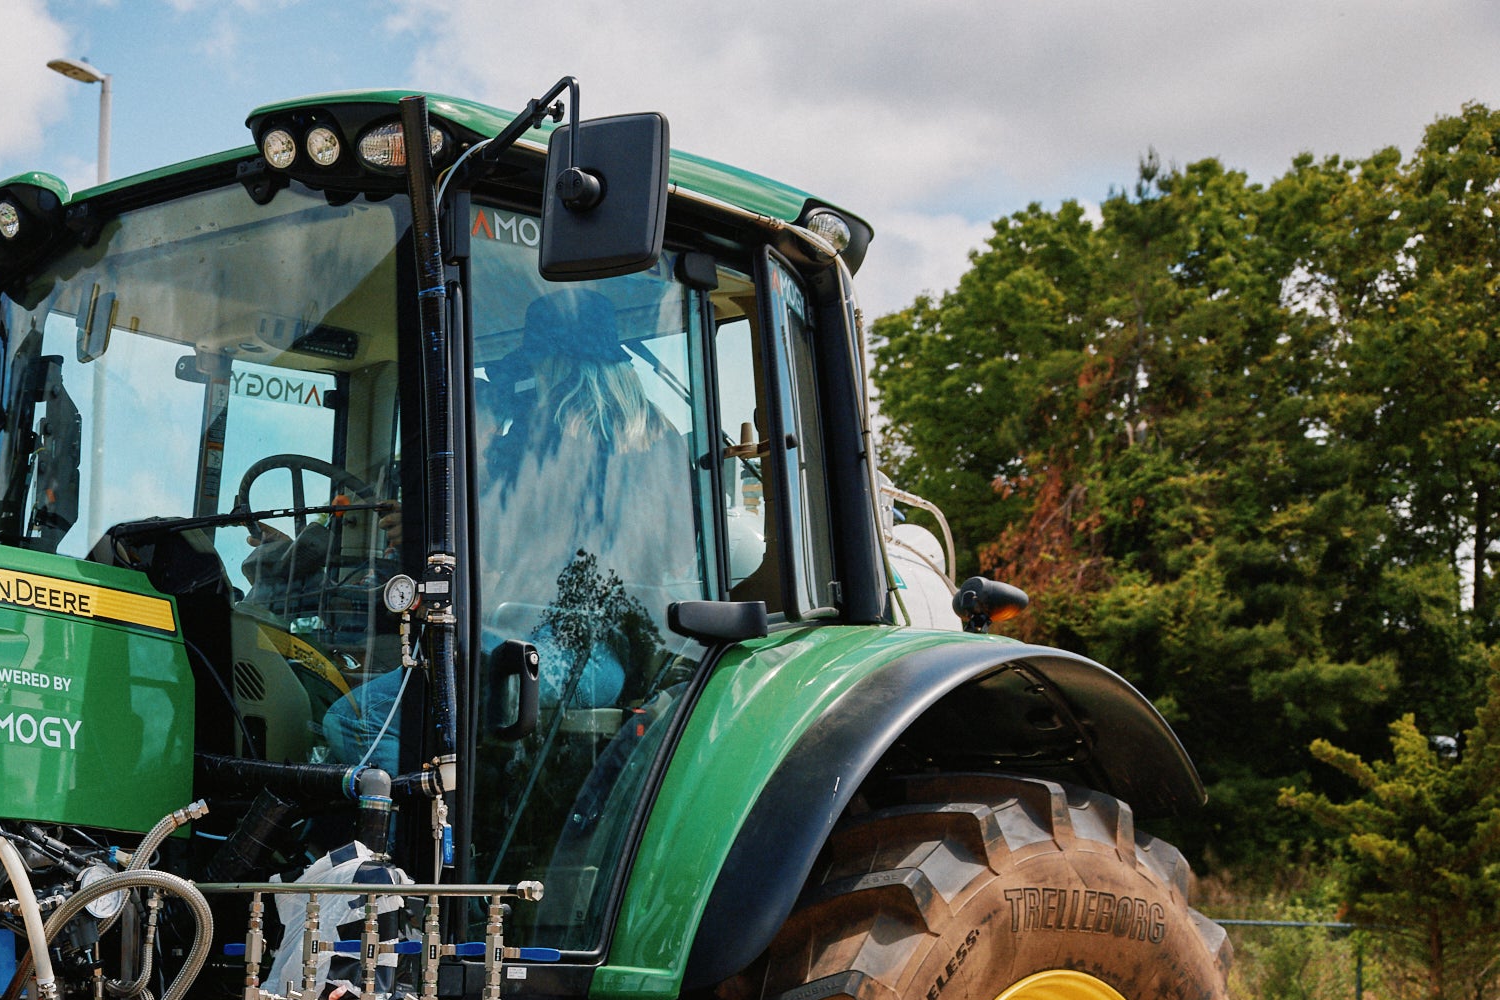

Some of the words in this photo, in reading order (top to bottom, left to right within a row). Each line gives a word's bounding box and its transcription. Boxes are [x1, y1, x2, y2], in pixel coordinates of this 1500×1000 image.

[471, 208, 541, 247] AMO
[15, 578, 91, 613] DEERE
[53, 676, 72, 692] BY
[1003, 887, 1166, 944] TRELLEBORG
